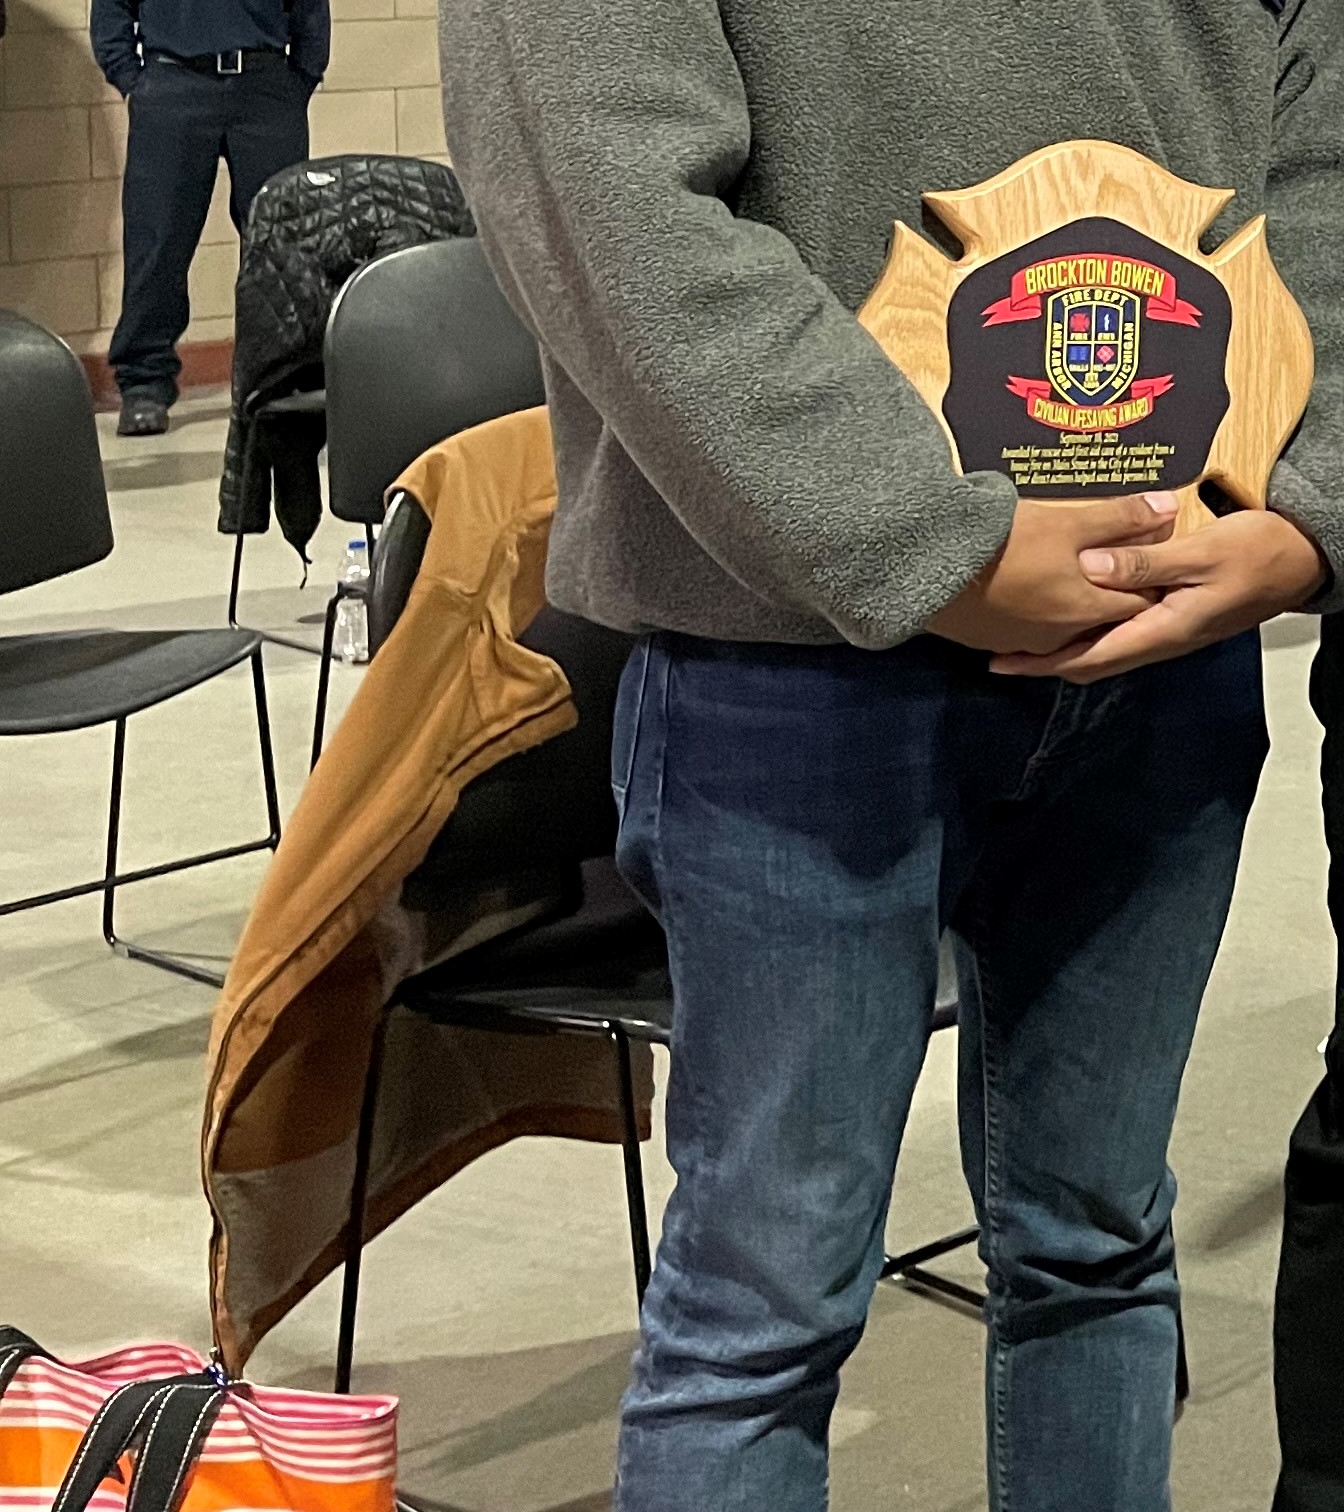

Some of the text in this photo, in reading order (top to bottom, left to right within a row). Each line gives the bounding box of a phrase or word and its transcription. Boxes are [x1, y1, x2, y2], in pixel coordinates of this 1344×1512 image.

[1025, 258, 1165, 297] BROCKTON BOWEN
[1061, 289, 1128, 306] FIRE DEPT
[1051, 322, 1072, 391] ANN ARBOR
[1111, 322, 1134, 390] MICHIGAN
[1034, 396, 1149, 429] CIVILIAN LIFESAVING AWARD
